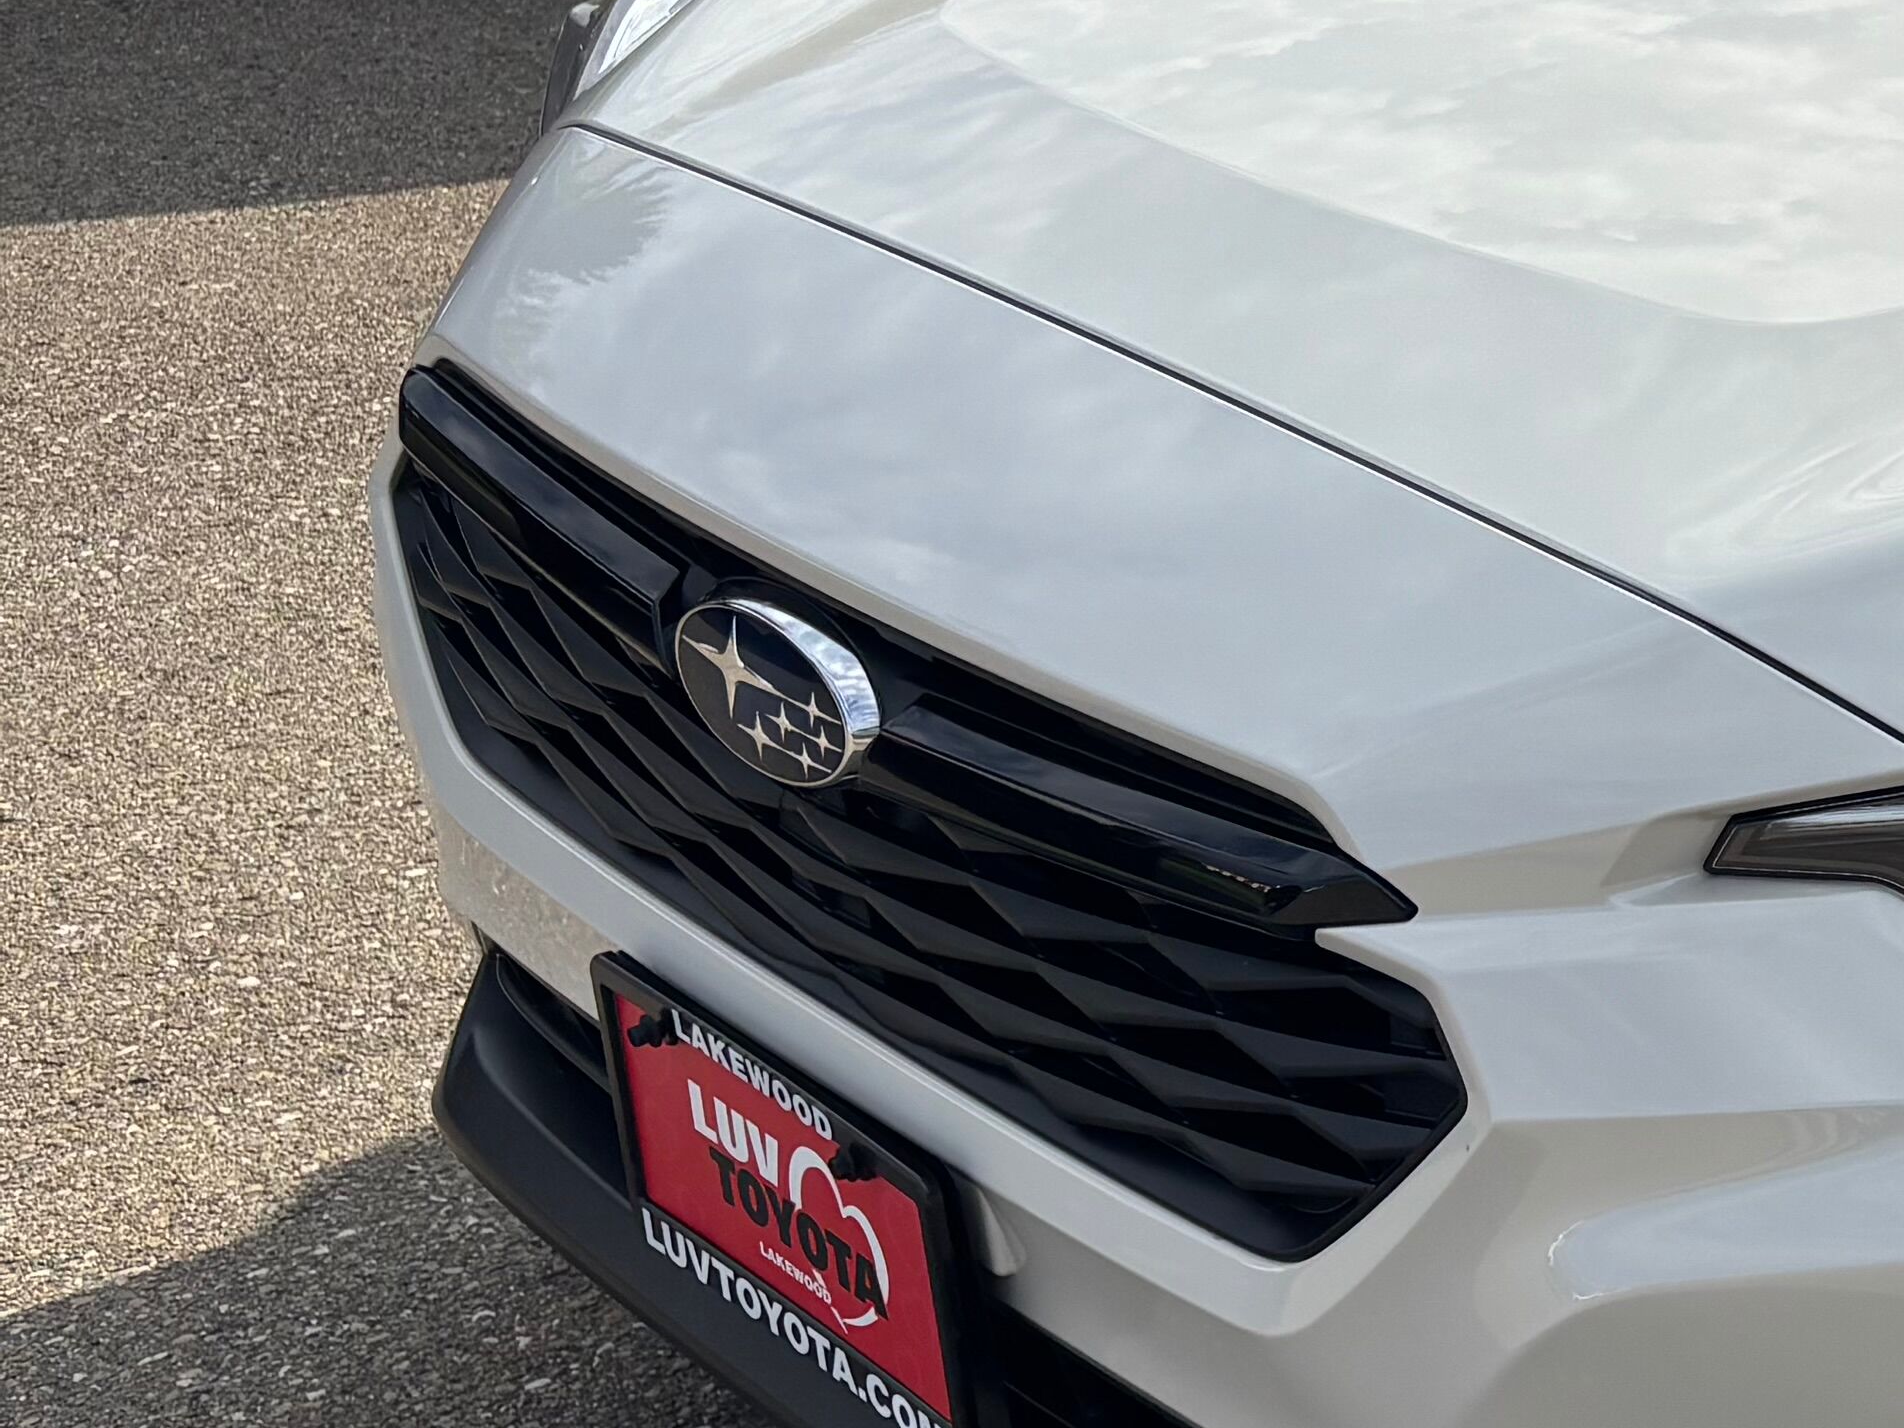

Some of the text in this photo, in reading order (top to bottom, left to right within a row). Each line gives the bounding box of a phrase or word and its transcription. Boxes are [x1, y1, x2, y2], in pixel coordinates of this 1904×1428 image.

[671, 1008, 834, 1141] LAKEWOOD
[686, 1078, 780, 1188] LUV
[709, 1147, 889, 1321] TOYOTA
[758, 1240, 833, 1306] LAKEWOOD
